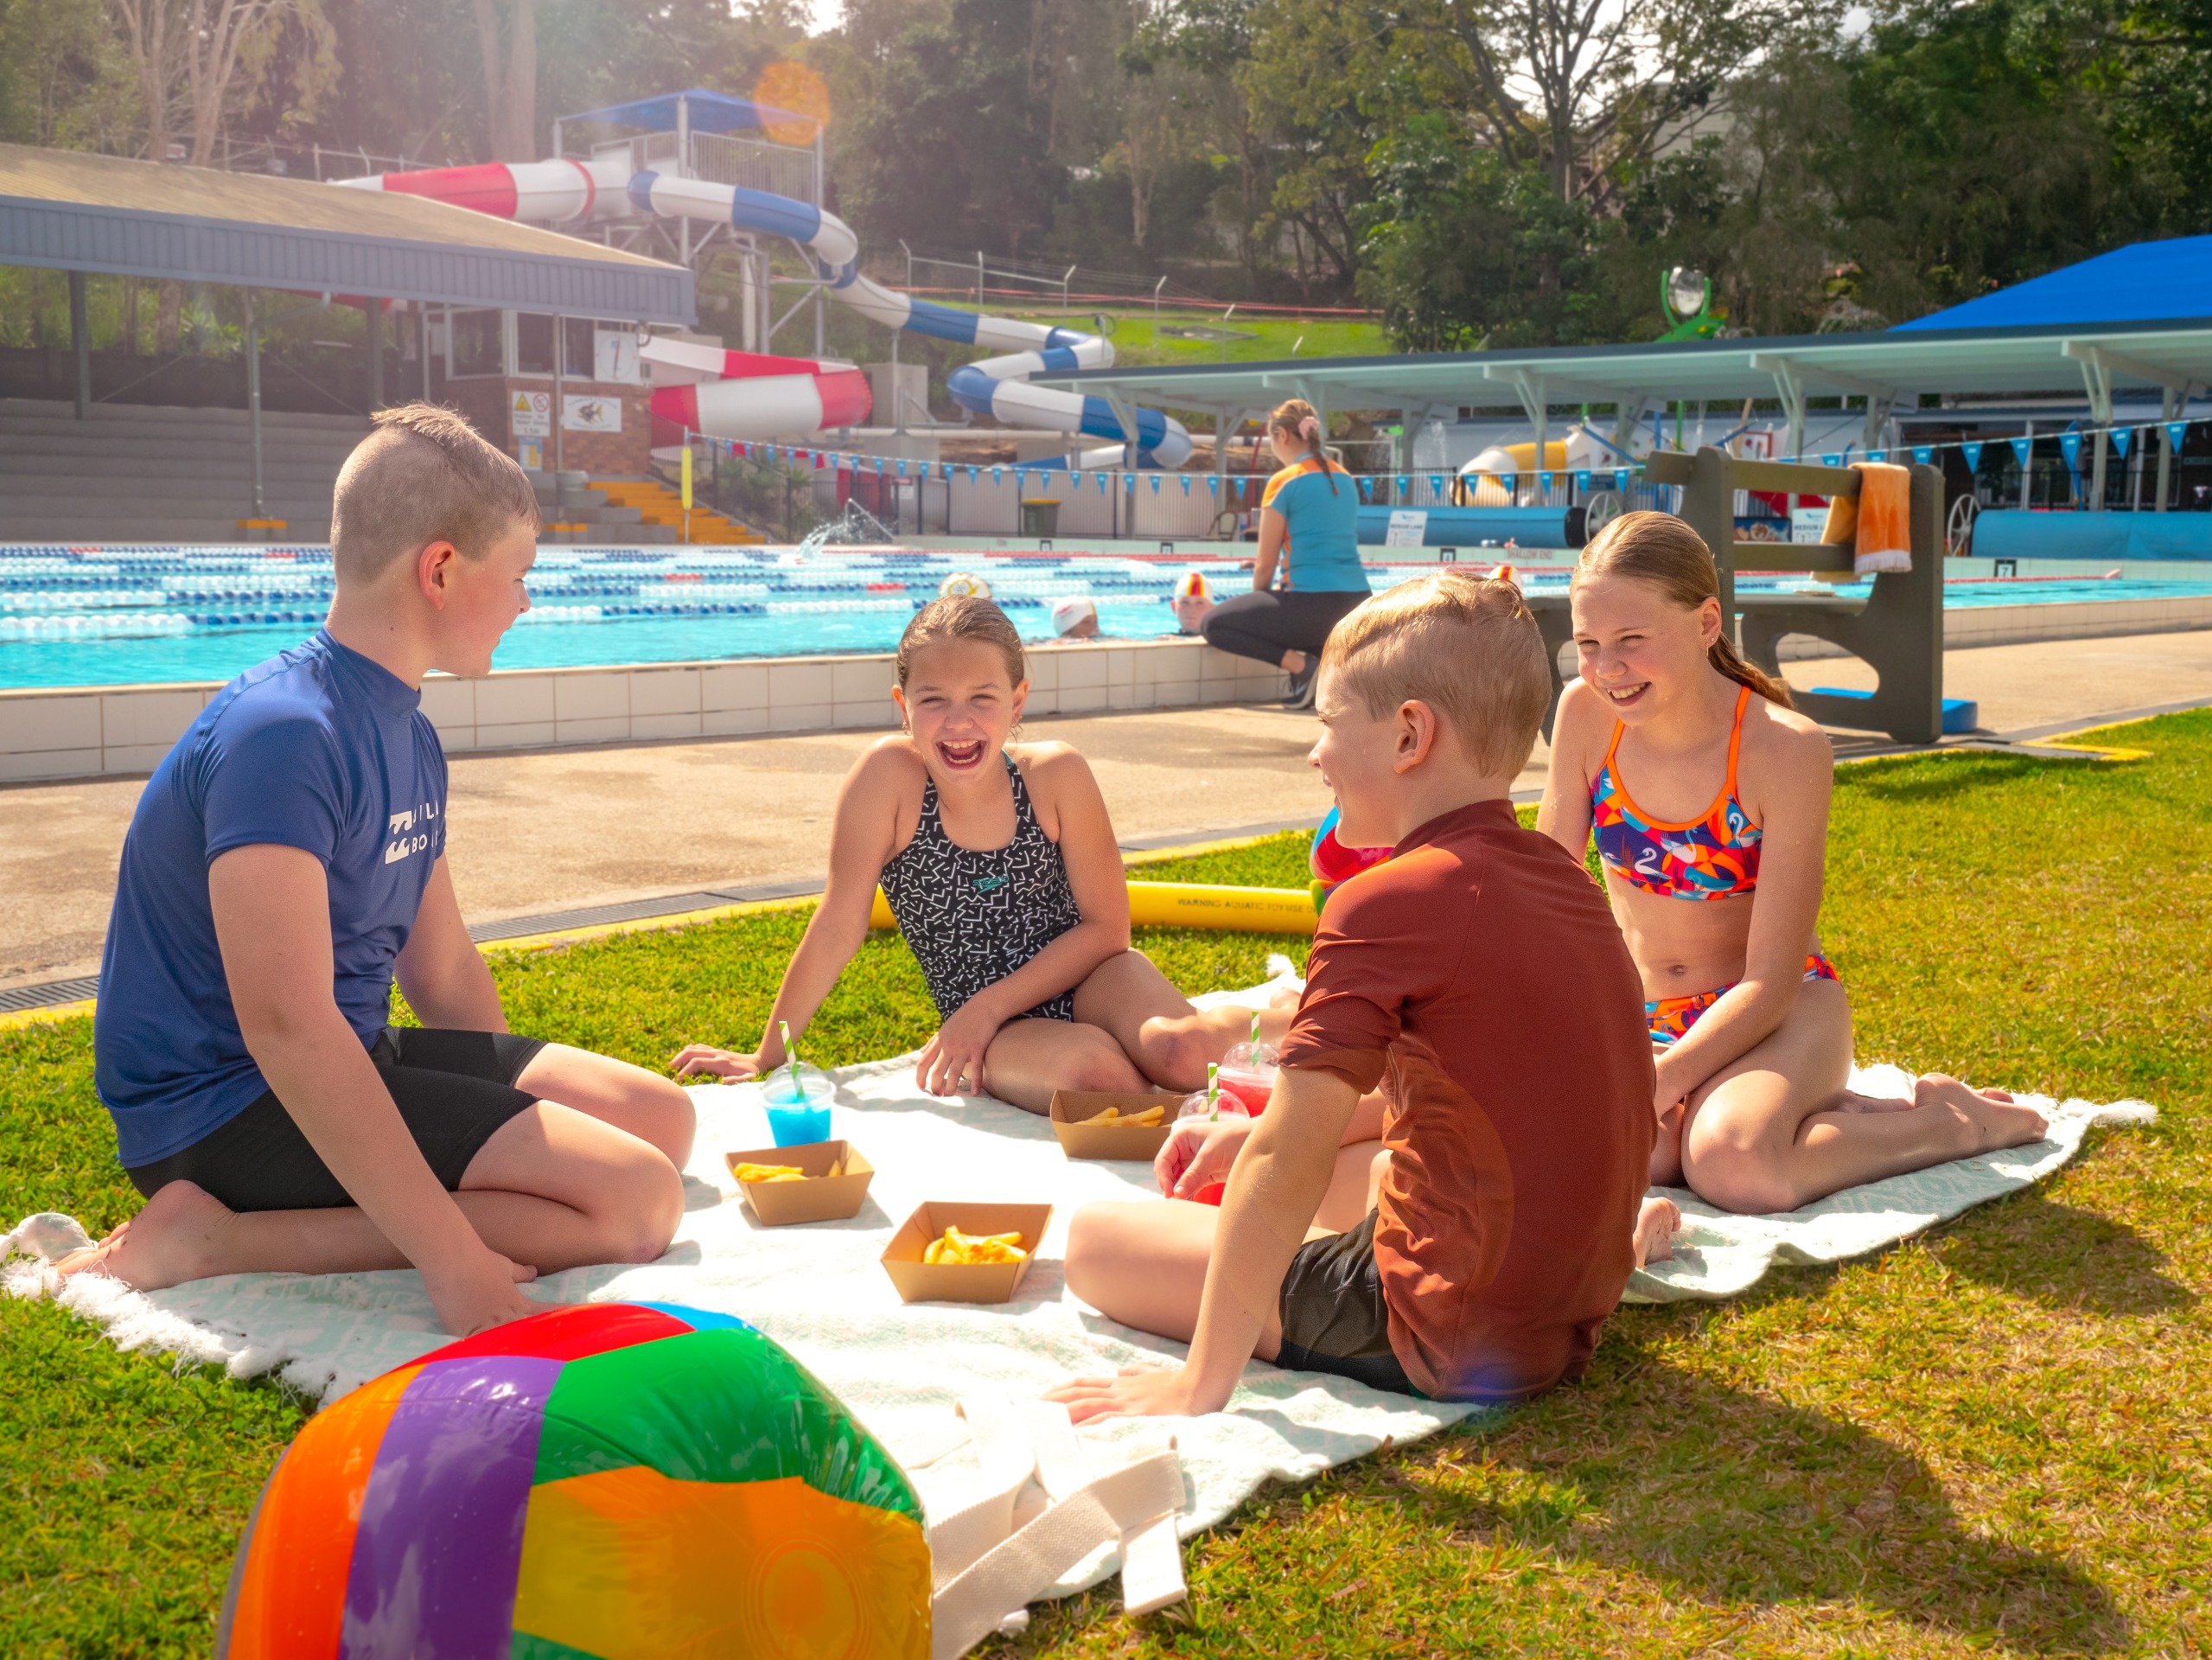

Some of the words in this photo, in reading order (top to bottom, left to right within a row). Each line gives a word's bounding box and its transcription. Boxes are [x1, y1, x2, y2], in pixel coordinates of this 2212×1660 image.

[2001, 566, 2009, 577] 7
[1177, 898, 1221, 908] WARNING
[1225, 901, 1265, 910] AQUATIC
[1285, 904, 1304, 913] USE
